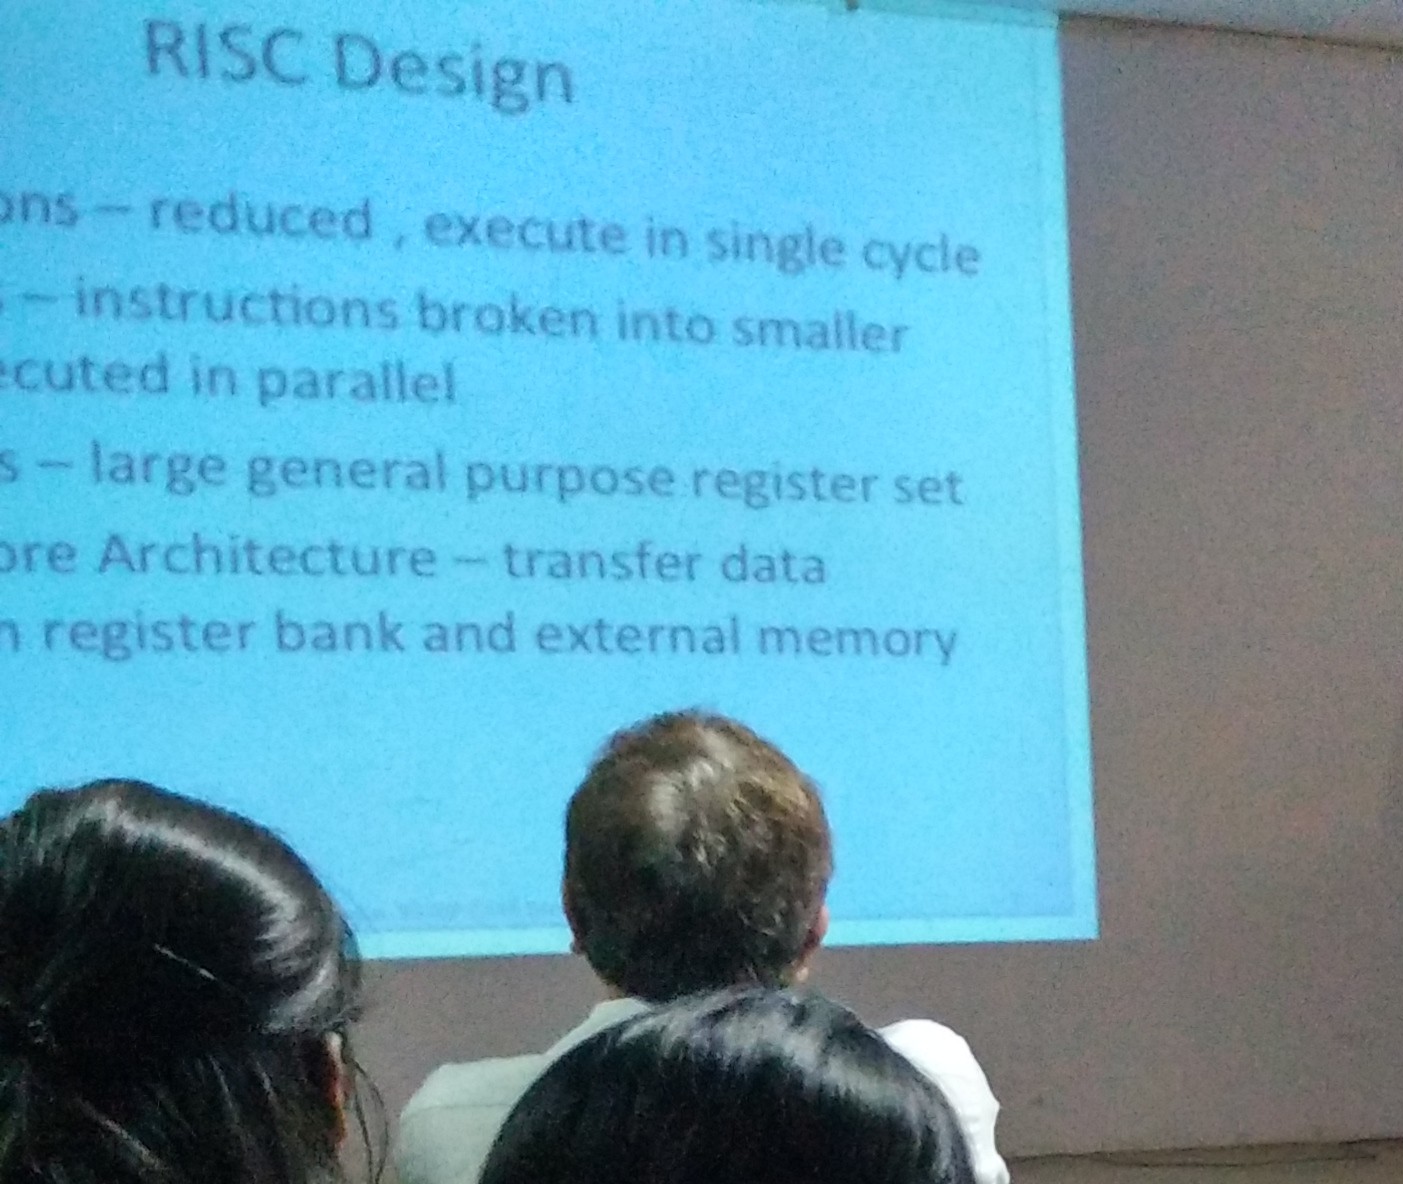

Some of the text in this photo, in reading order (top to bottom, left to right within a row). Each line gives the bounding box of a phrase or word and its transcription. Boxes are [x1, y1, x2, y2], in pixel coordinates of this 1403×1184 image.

[144, 19, 574, 116] RISC Design
[150, 192, 373, 242] reduced
[423, 212, 627, 255] execute
[646, 216, 689, 258] in
[707, 221, 845, 275] single
[862, 233, 981, 281] cycle
[74, 277, 398, 330] instructions
[416, 290, 599, 340] broken
[618, 307, 718, 345] into
[733, 310, 909, 355] smaller
[0, 352, 456, 408] cuted in parallel
[91, 439, 227, 495] large
[247, 449, 448, 497] general
[465, 461, 676, 504] purpose
[692, 467, 879, 511] register
[894, 471, 963, 506] set
[95, 532, 438, 578] Architecture
[720, 543, 826, 585] data
[0, 619, 21, 653] n
[43, 615, 255, 663] register
[274, 609, 406, 653] bank
[422, 611, 516, 654] and
